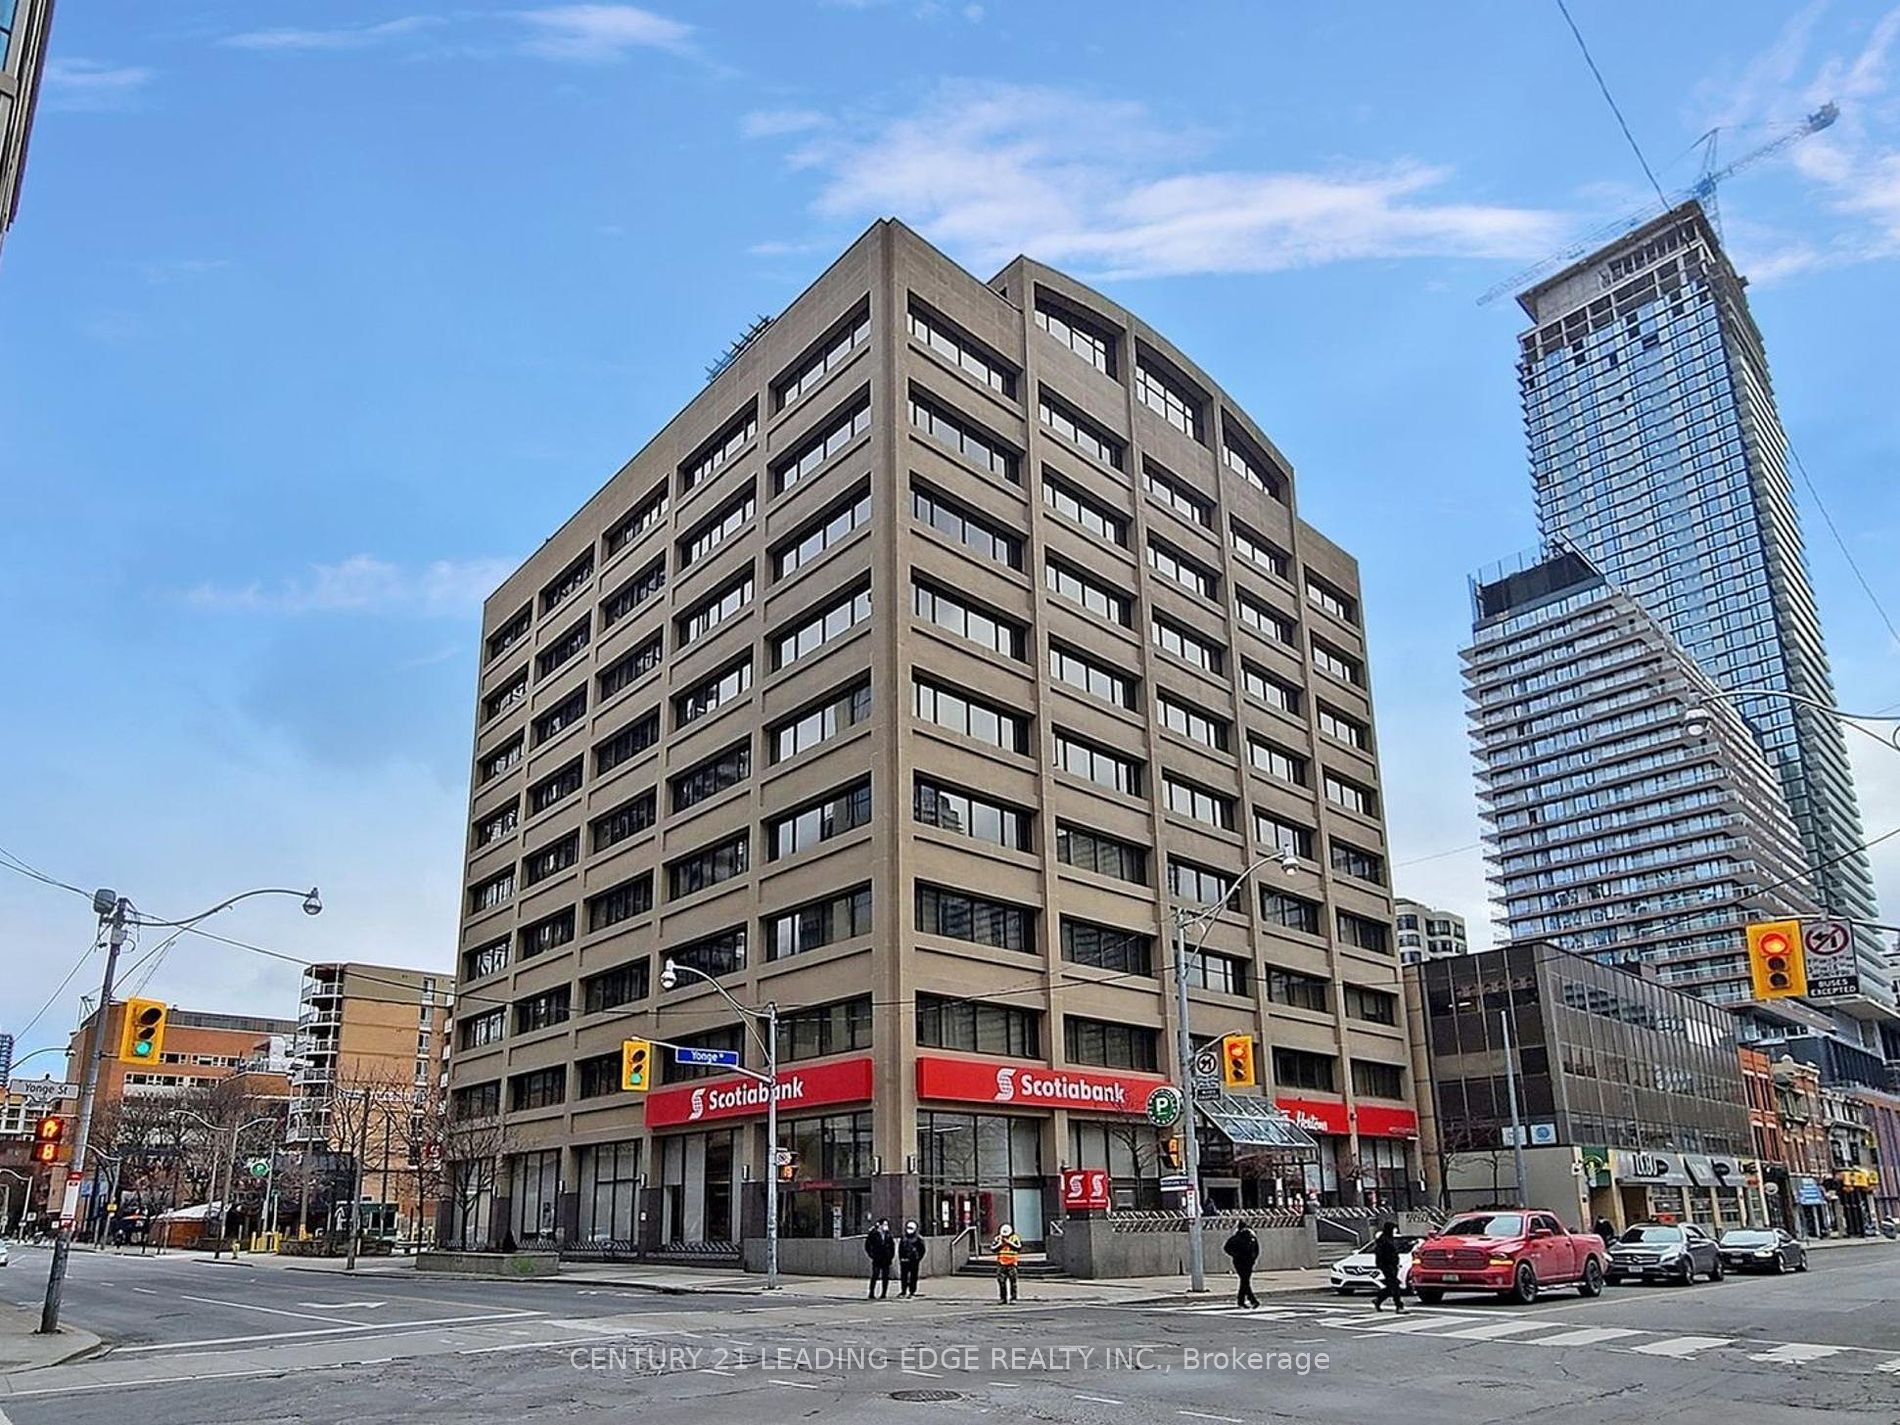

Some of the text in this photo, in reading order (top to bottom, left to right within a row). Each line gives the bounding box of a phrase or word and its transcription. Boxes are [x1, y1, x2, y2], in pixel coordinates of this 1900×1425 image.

[1818, 978, 1849, 988] BUSES
[1810, 985, 1857, 997] EXCEPTED
[690, 1050, 718, 1064] Yonge
[24, 1083, 69, 1096] Yonge St
[708, 1075, 804, 1111] Scotiabank
[1020, 1073, 1126, 1104] Scotiabank
[1155, 1097, 1169, 1113] P
